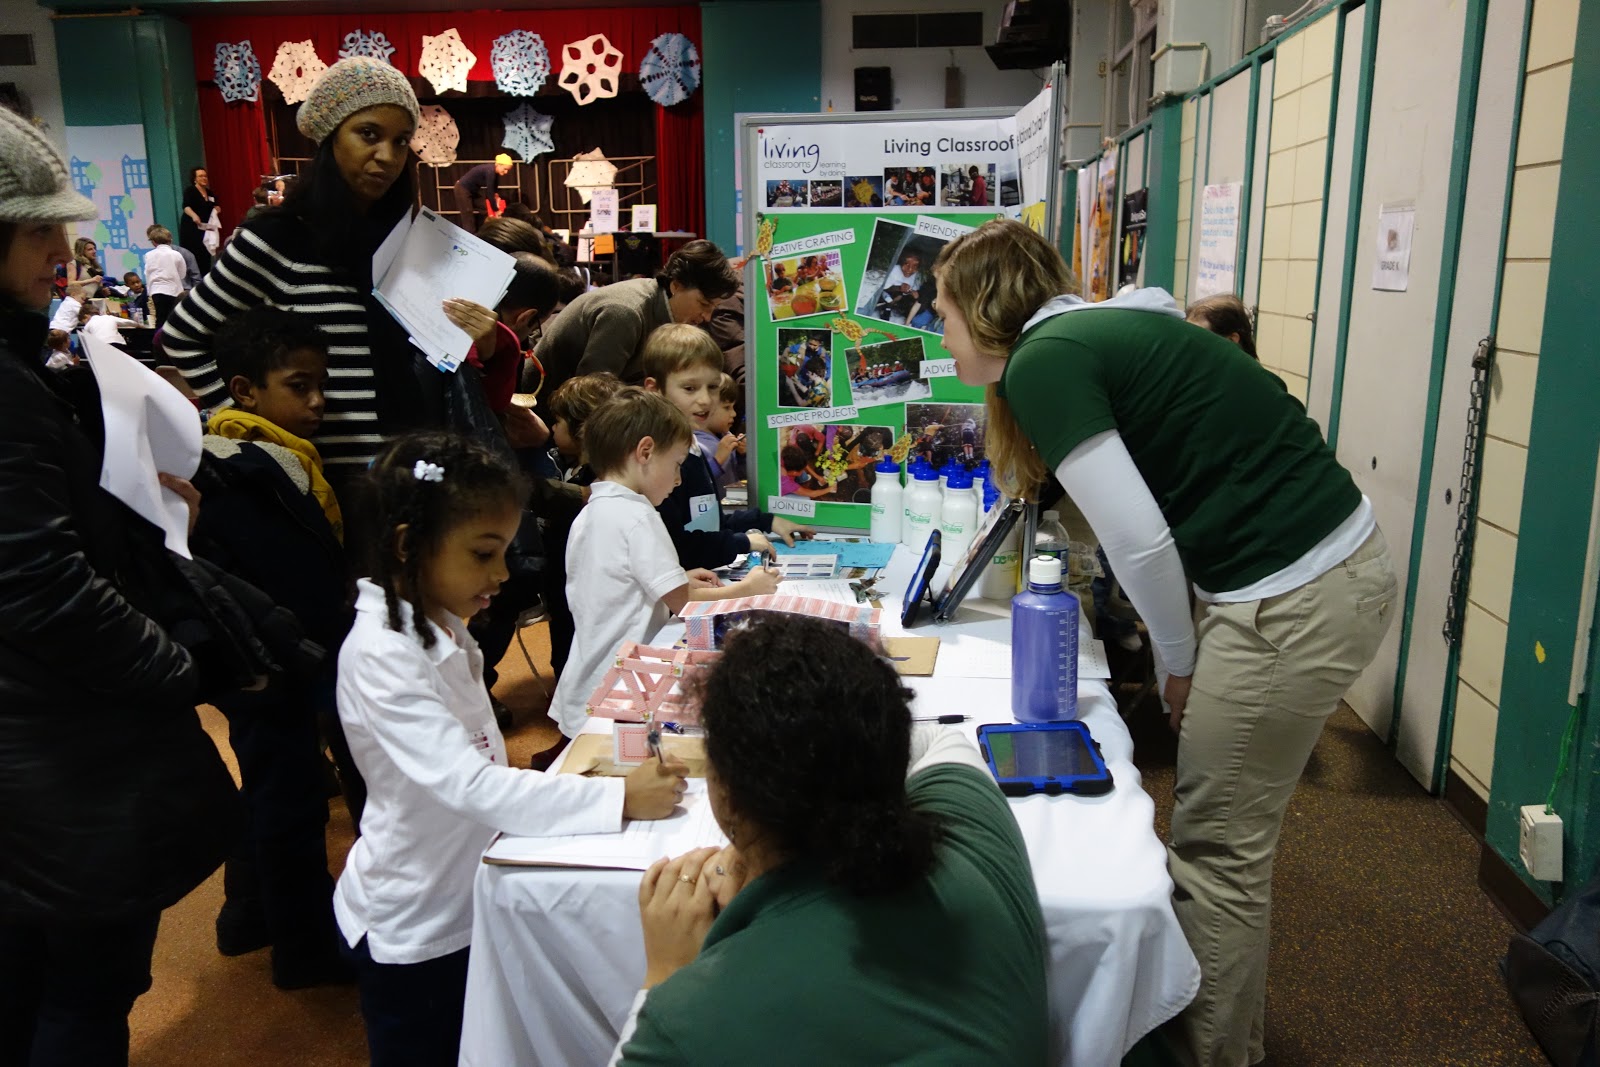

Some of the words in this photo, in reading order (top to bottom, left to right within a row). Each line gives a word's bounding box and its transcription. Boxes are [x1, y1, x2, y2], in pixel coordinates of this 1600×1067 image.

[764, 137, 820, 174] living
[884, 138, 931, 156] Living
[764, 161, 811, 169] classrooms
[820, 161, 846, 169] learning
[919, 221, 958, 238] FRIENDS
[768, 241, 803, 255] REATIVE
[805, 231, 853, 248] CRAFTING
[770, 412, 809, 425] SCIENCE
[811, 406, 857, 420] PROJECTS
[773, 501, 795, 510] JOIN
[797, 503, 811, 513] US!
